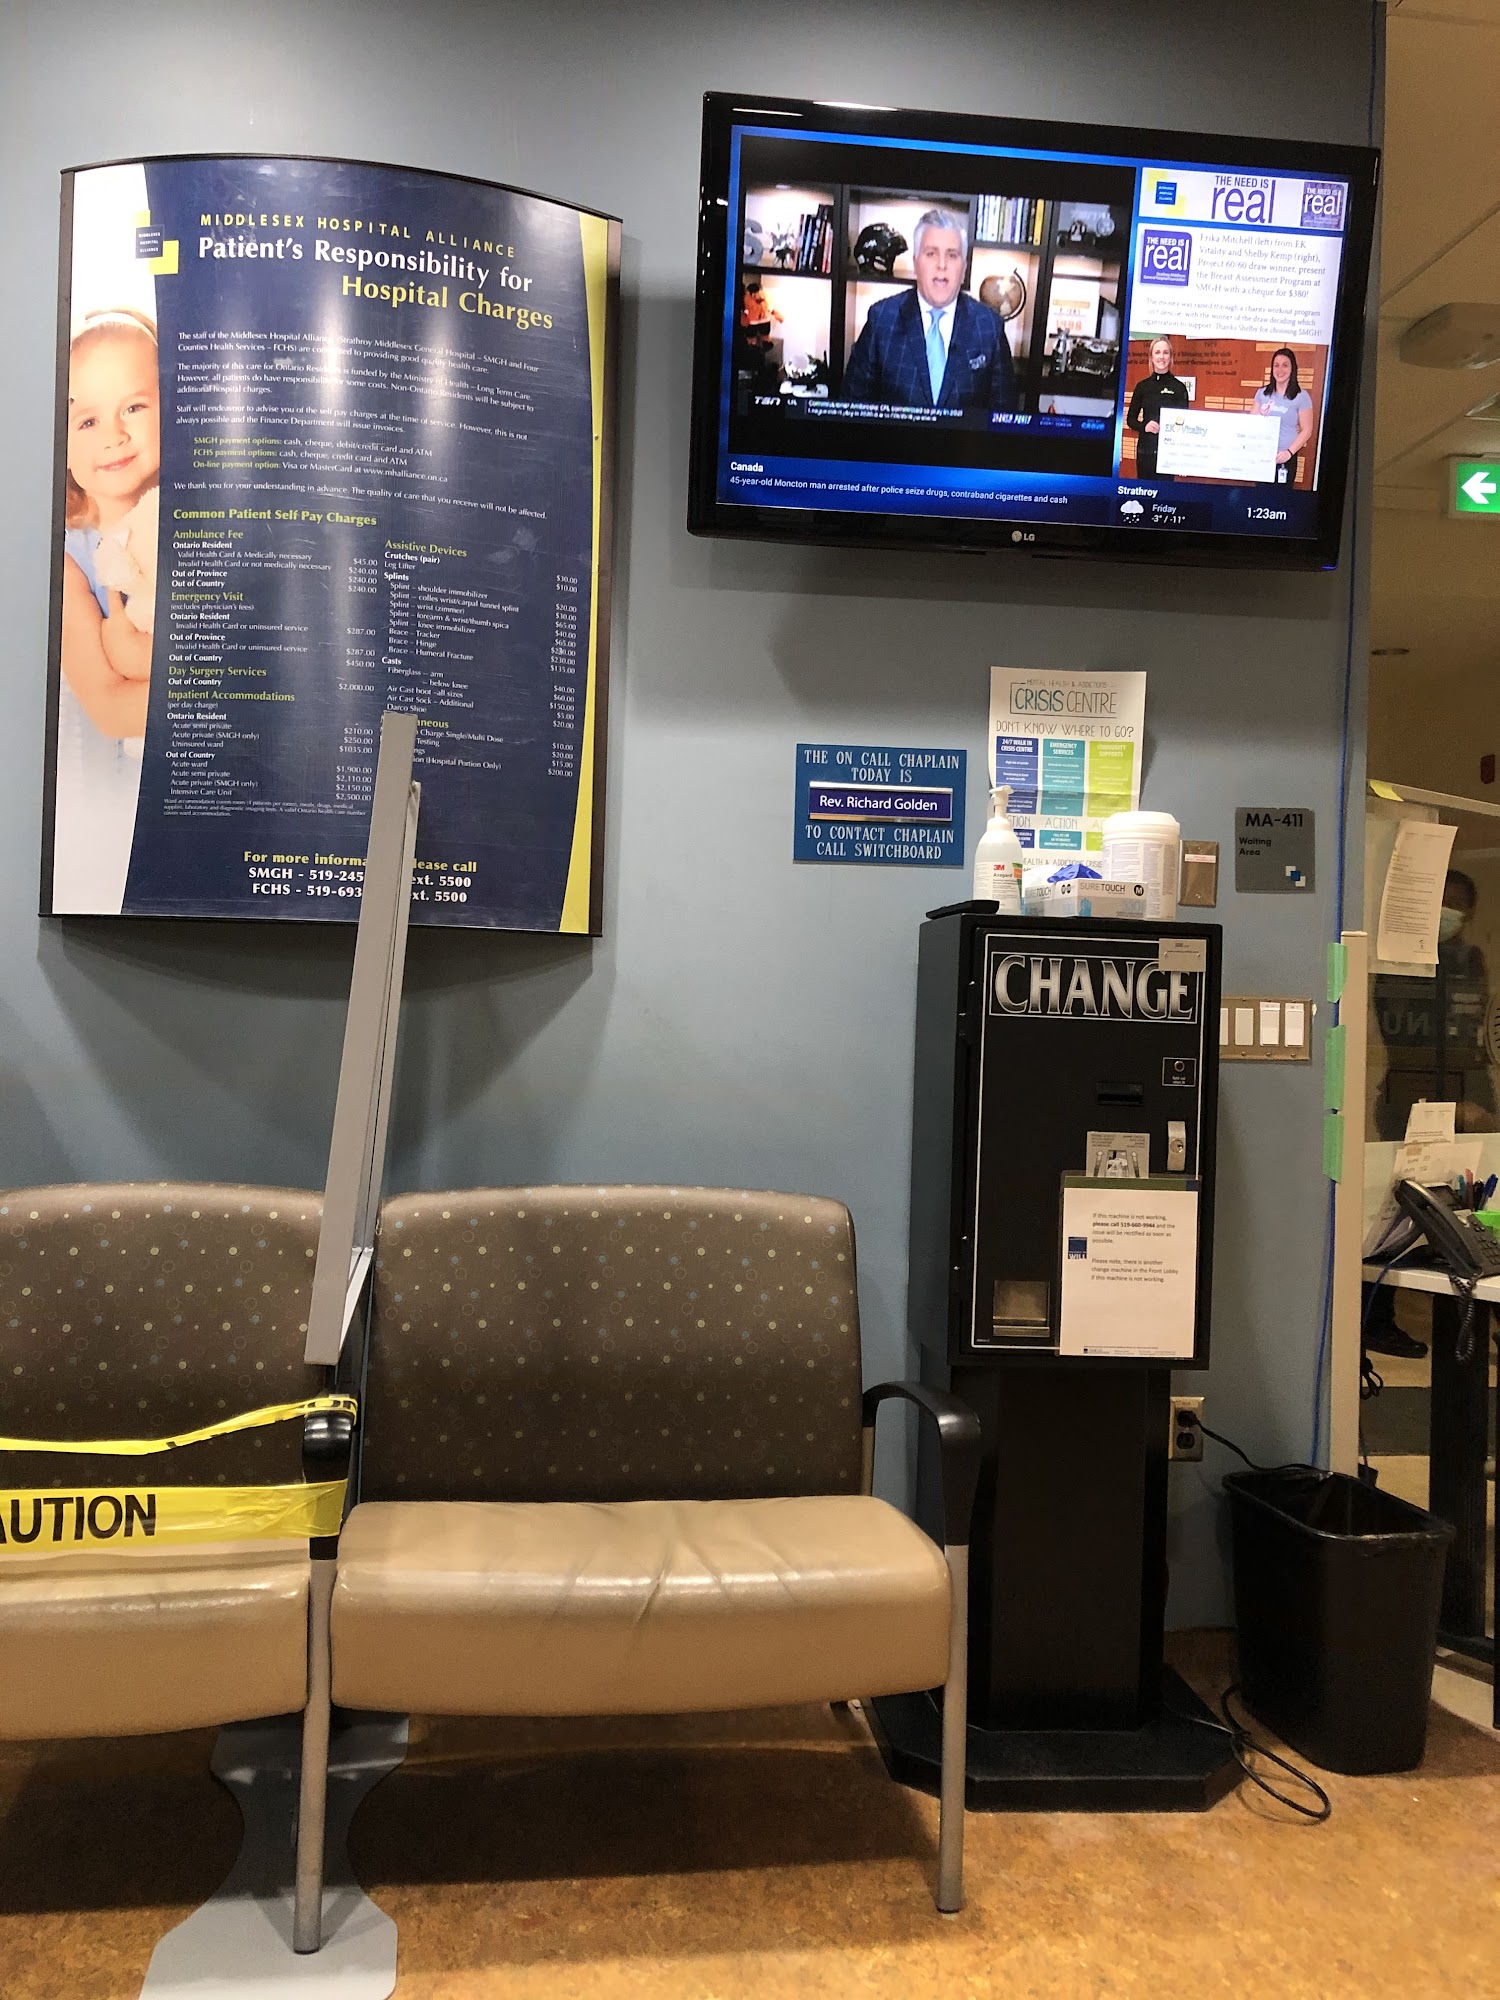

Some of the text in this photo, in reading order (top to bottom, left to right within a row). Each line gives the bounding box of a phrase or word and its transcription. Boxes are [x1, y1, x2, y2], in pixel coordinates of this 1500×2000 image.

[1215, 175, 1269, 188] THE NEED IS
[1211, 180, 1276, 224] real
[1304, 190, 1341, 215] real
[200, 214, 515, 258] MIDDLESEX HOSPITAL ALLIANCE
[1160, 238, 1176, 246] NEED
[1222, 235, 1253, 244] Mitchell
[1255, 238, 1272, 246] (left)
[1275, 238, 1292, 247] from
[1295, 239, 1306, 248] EK
[1144, 240, 1189, 270] real
[1228, 248, 1242, 256] and
[1244, 249, 1267, 259] Shelby
[1271, 250, 1292, 261] Kemp
[199, 235, 533, 292] Patient's Responsibility for
[342, 275, 553, 330] Hospital Charges
[252, 438, 282, 446] options:
[305, 439, 334, 448] cheque,
[336, 441, 379, 452] debit/credit
[381, 444, 397, 452] card
[415, 449, 432, 457] ATM
[730, 462, 764, 472] Canada
[730, 476, 772, 486] 45-year-old
[774, 479, 808, 488] Moncton
[828, 482, 859, 491] arrested
[861, 484, 879, 492] after
[881, 486, 903, 495] police
[905, 487, 924, 495] seize
[926, 488, 949, 498] drugs,
[951, 490, 994, 499] contraband
[995, 493, 1032, 502] cigarettes
[1050, 496, 1068, 504] cash
[1118, 486, 1158, 498] Strathroy
[1152, 504, 1176, 514] Friday
[1247, 507, 1286, 520] 1:23am
[174, 509, 377, 527] Common Patient Self Pay Charges
[174, 530, 243, 539] Ambulance Fee
[1023, 533, 1035, 542] LG
[385, 540, 467, 557] Assistive Devices
[353, 558, 377, 566] $45.00
[385, 552, 440, 564] Crutches (pair)
[349, 576, 377, 585] $240.00
[384, 572, 409, 581] Splints
[557, 575, 578, 584] $30.00
[557, 584, 577, 593] $10.00
[172, 592, 243, 604] Emergency Visit
[556, 604, 577, 613] $20.00
[382, 657, 401, 665] Casts
[169, 667, 267, 677] Day Surgery Services
[168, 690, 295, 701] Inpatient Accommodations
[1015, 688, 1118, 714] CRISIS CENTRE
[344, 727, 373, 735] $210.00
[996, 720, 1134, 738] DON'T KNOW WHERE TO GO?
[805, 750, 959, 769] THE ON CALL CHAPLAIN
[548, 769, 573, 778] $200.00
[851, 767, 912, 783] TODAY IS
[336, 793, 371, 801] $2,500.00
[820, 795, 937, 810] Rev. Richard Golden
[1007, 816, 1078, 829] TION ACTION
[1245, 813, 1303, 827] MA-411
[805, 825, 954, 843] TO CONTACT CHAPLAIN
[1239, 837, 1271, 847] Waiting
[817, 842, 941, 859] CALL SWITCHBOARD
[244, 851, 477, 872] For more informa lease call
[248, 867, 293, 879] SMGH
[309, 870, 364, 881] 519-245
[439, 876, 472, 887] 5500
[252, 883, 467, 902] FCHS 519-693 xt. 5500
[1080, 882, 1125, 892] SURETOUCH
[995, 955, 1193, 1019] CHANGE
[0, 1494, 156, 1544] UTION
